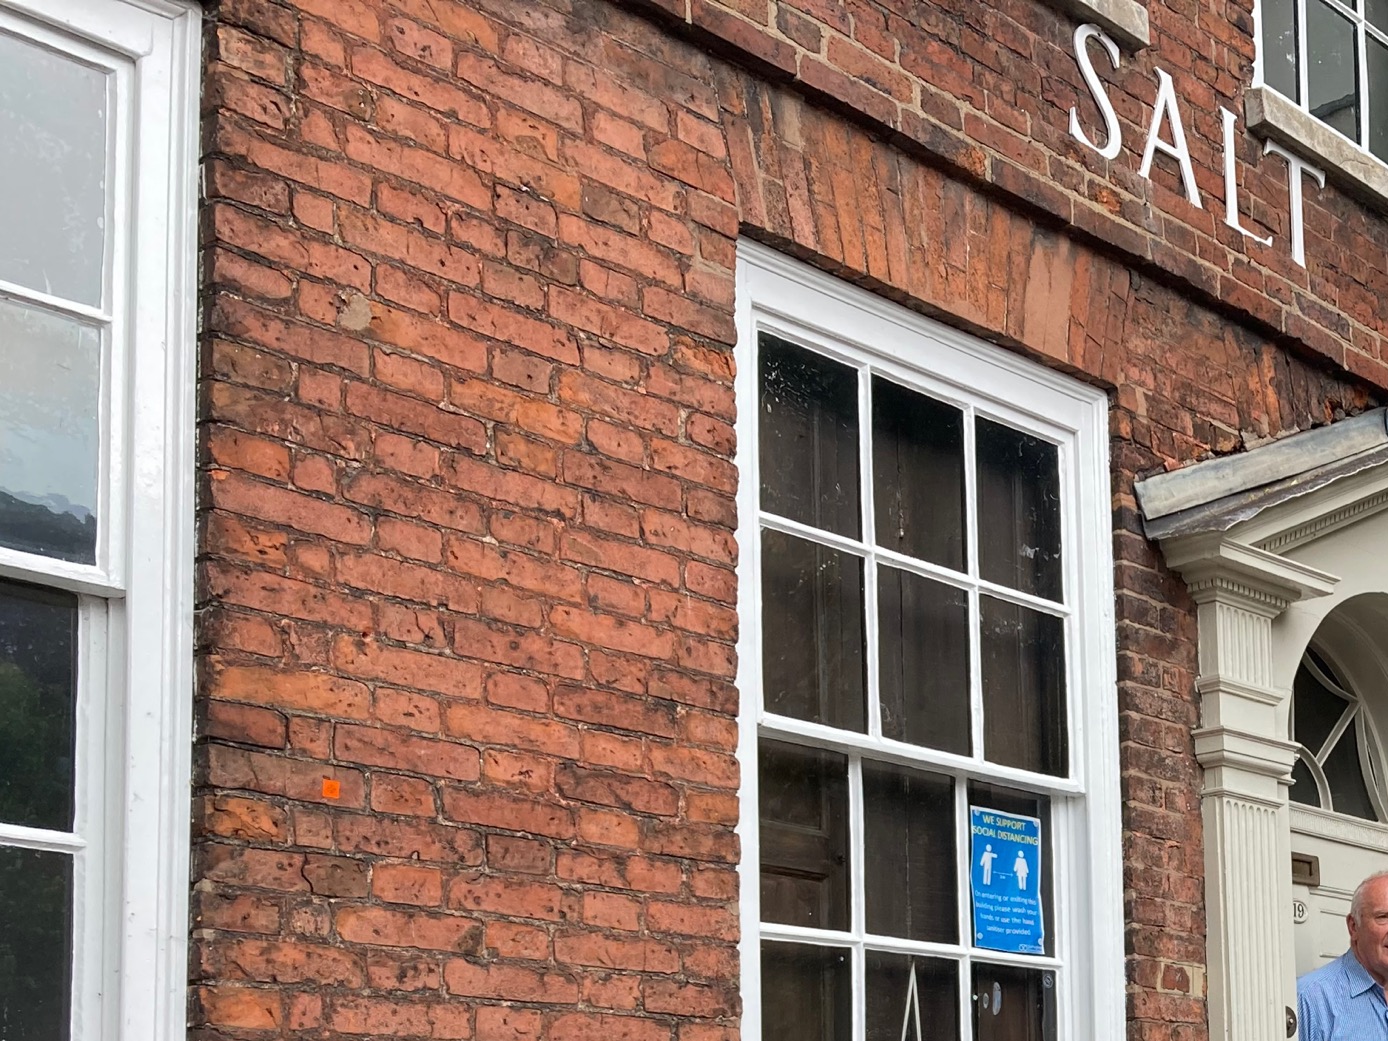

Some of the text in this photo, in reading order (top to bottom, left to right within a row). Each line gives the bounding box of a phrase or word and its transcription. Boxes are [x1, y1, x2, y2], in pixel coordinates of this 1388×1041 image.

[1068, 23, 1326, 269] SALT
[982, 814, 1026, 831] WE SUPPORT
[972, 825, 1039, 846] SOCIAL DISTANCING
[981, 892, 1002, 902] entering
[994, 905, 1011, 913] please
